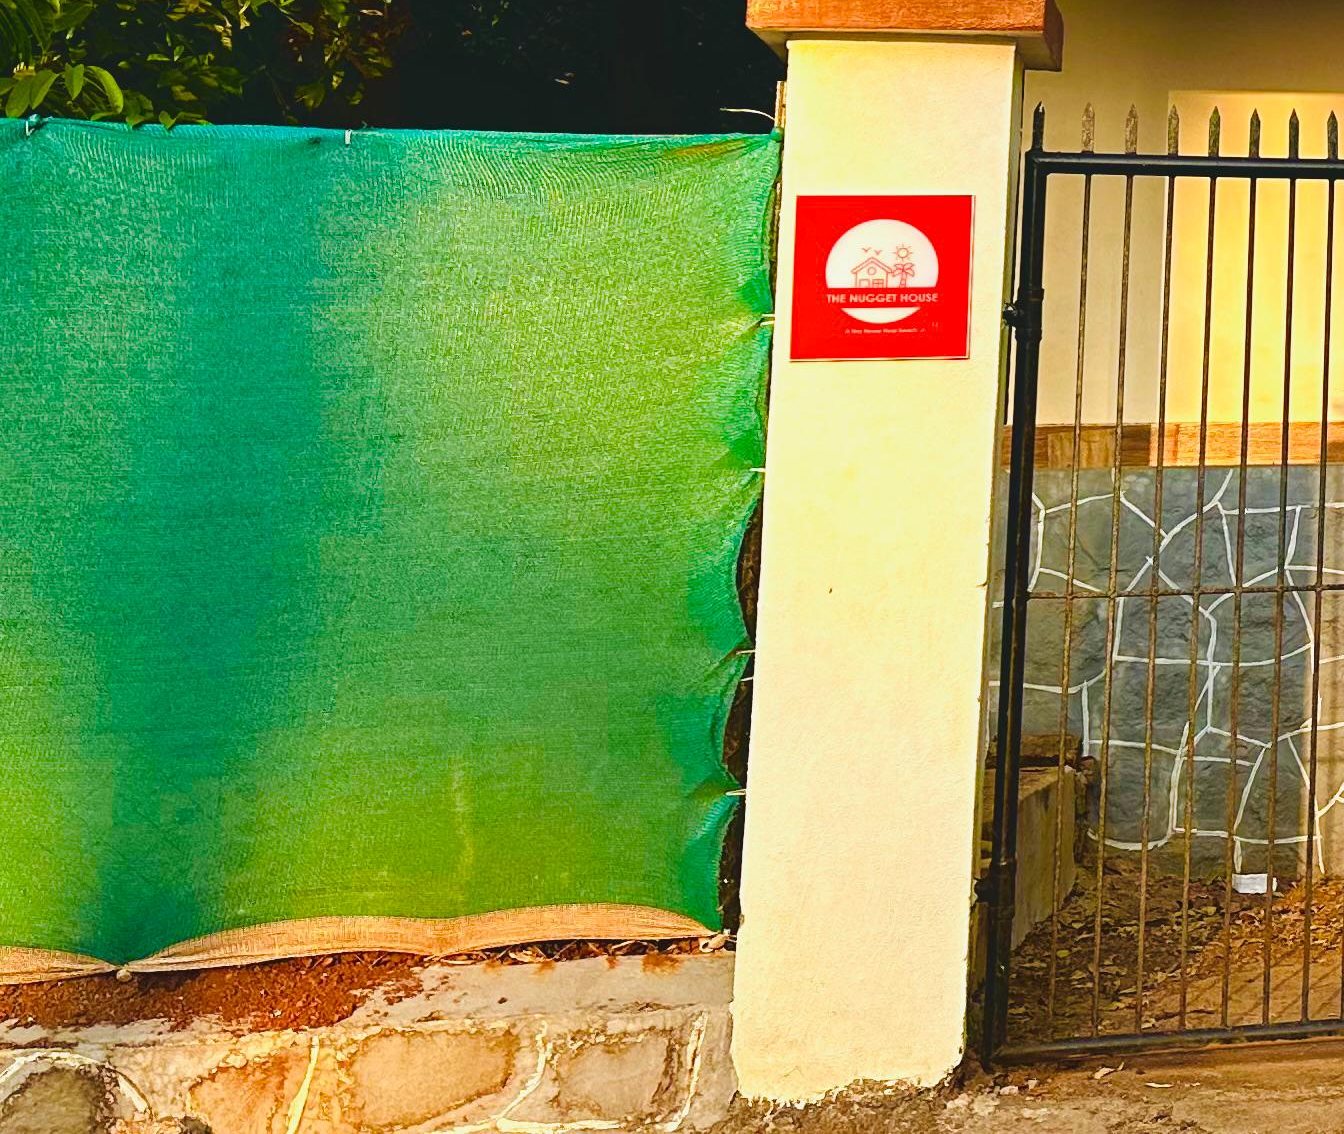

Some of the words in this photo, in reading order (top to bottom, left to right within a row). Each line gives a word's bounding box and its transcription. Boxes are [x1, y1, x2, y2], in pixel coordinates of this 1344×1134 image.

[826, 293, 846, 304] THE
[849, 293, 898, 303] NUGGET
[900, 293, 938, 303] HOUSE
